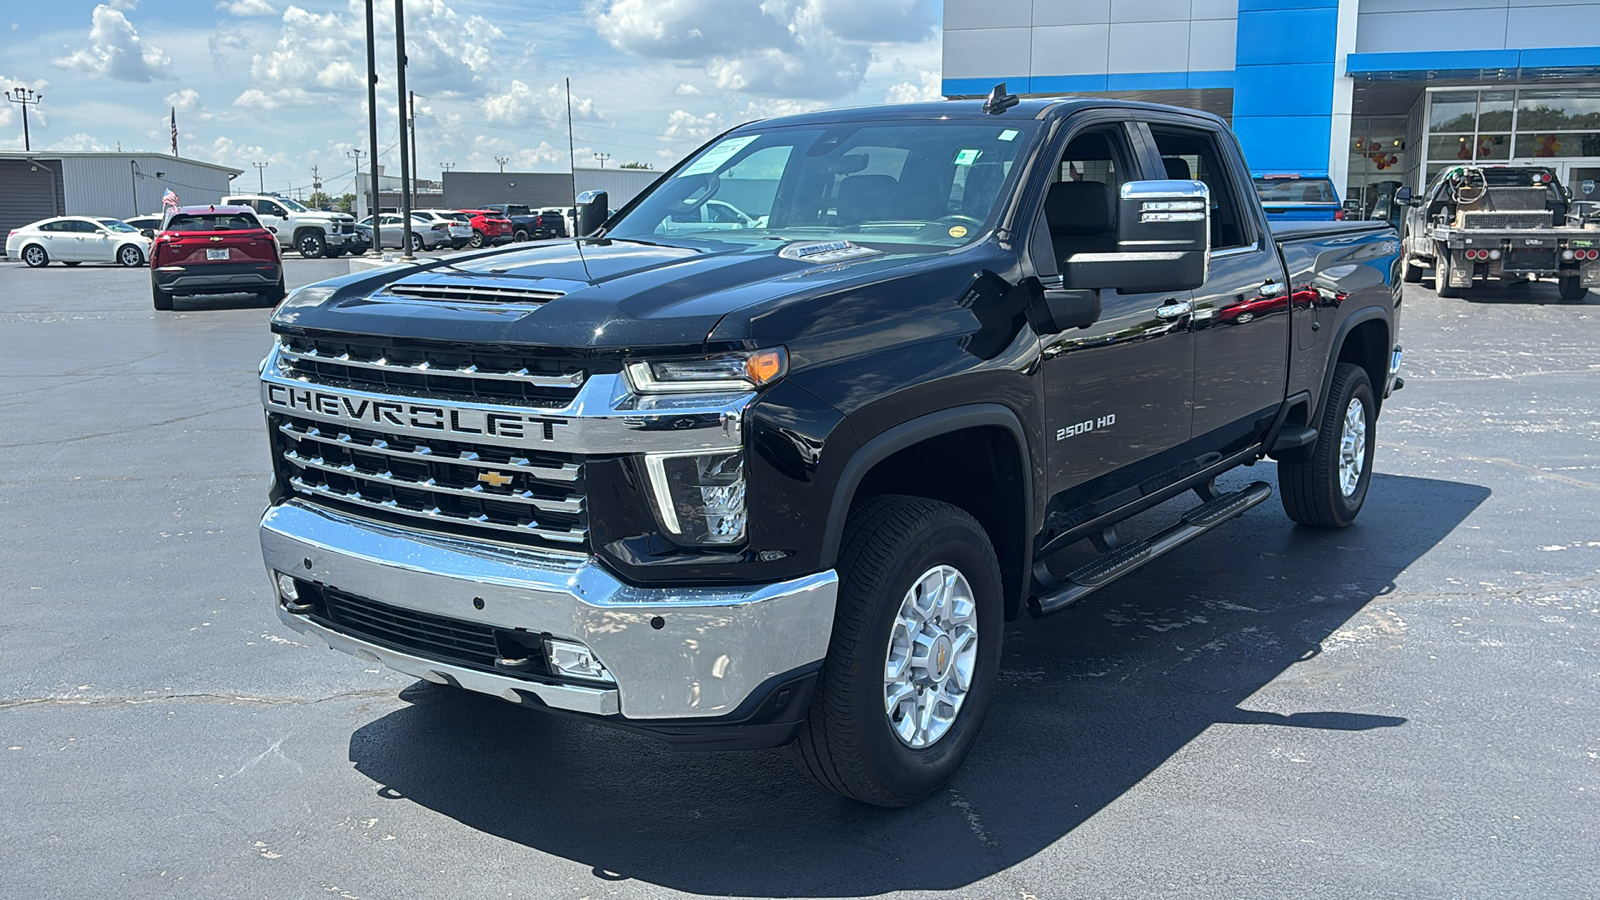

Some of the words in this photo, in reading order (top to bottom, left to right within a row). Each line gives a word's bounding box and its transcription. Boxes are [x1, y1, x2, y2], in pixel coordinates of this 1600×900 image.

[268, 384, 568, 441] CHEVROLET
[1056, 420, 1093, 441] 2500
[1096, 413, 1116, 429] HD
